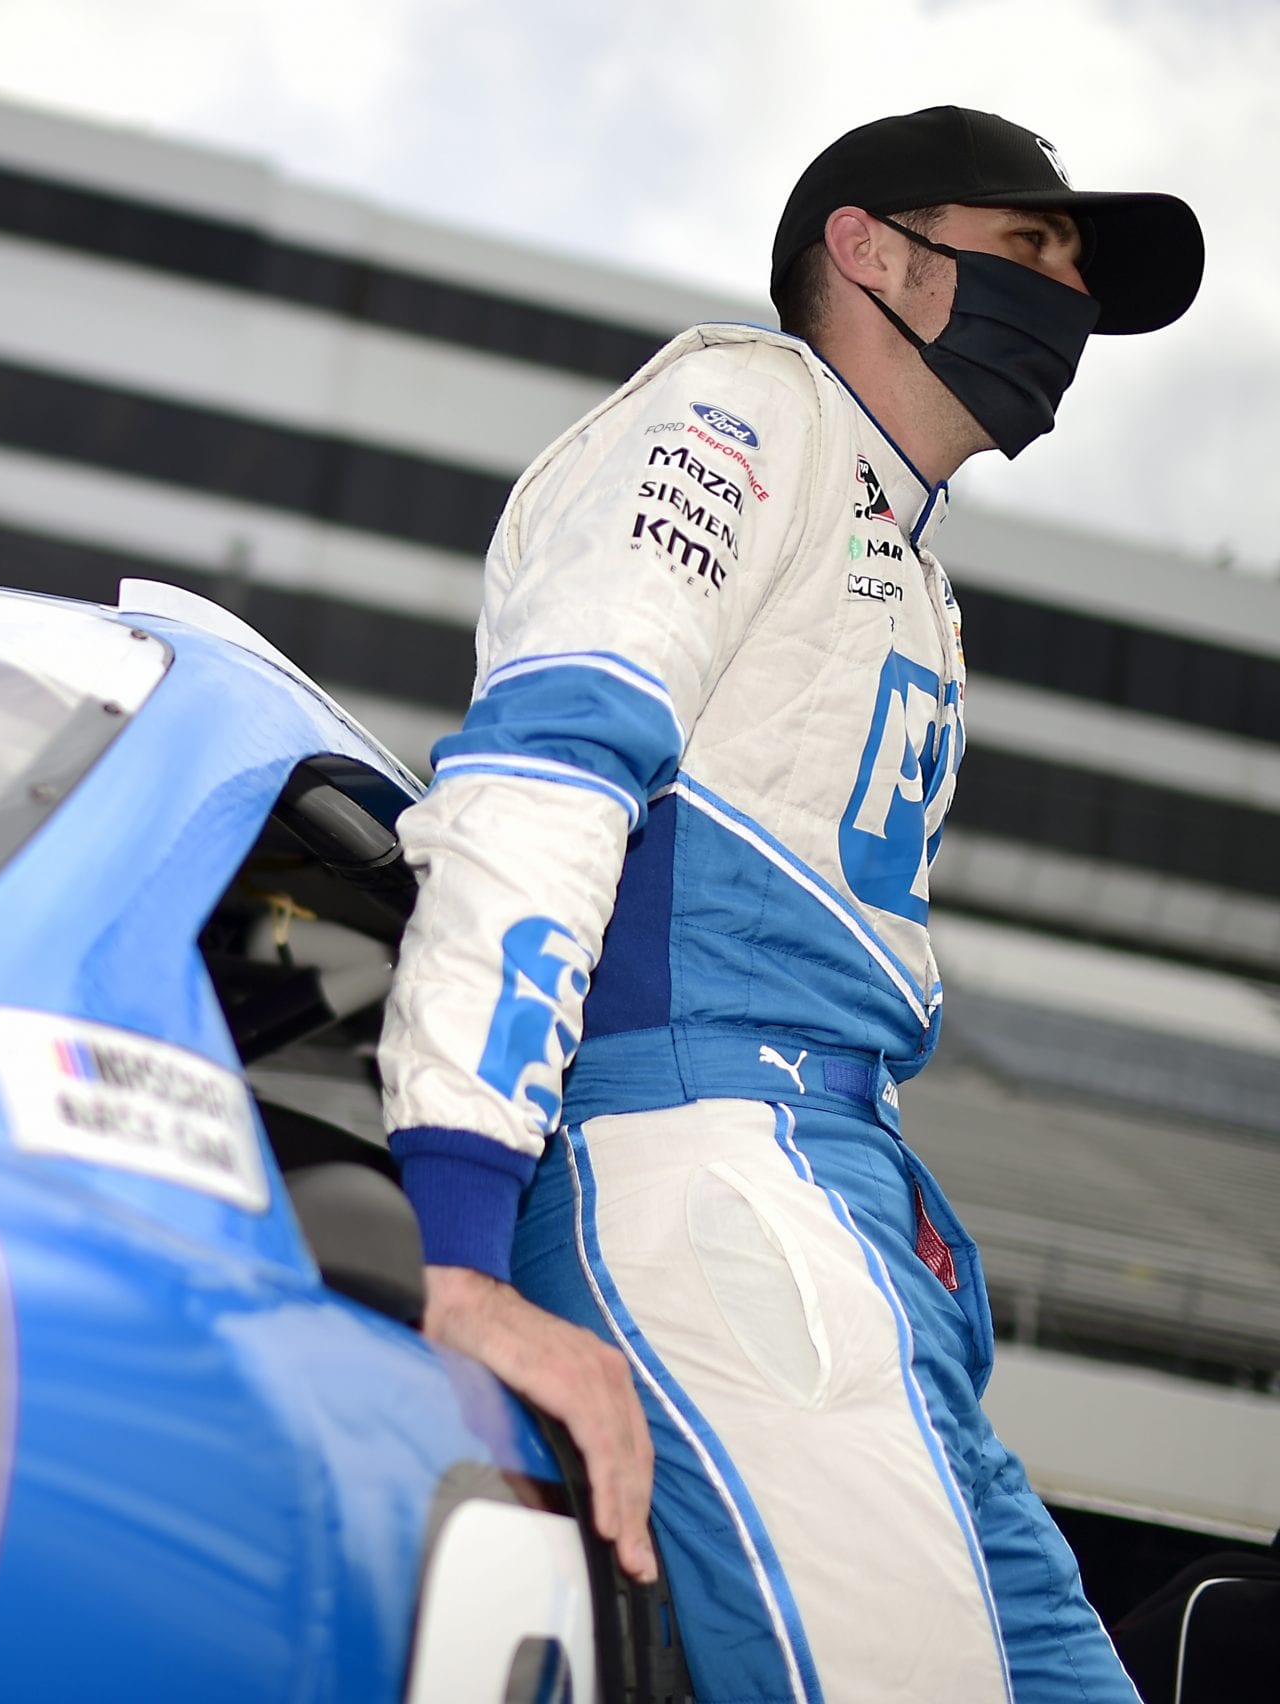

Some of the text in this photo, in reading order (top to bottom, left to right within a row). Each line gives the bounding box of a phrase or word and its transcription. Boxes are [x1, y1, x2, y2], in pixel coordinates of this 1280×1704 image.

[703, 409, 752, 442] Ford
[644, 422, 770, 502] FORD PERFORMANCE
